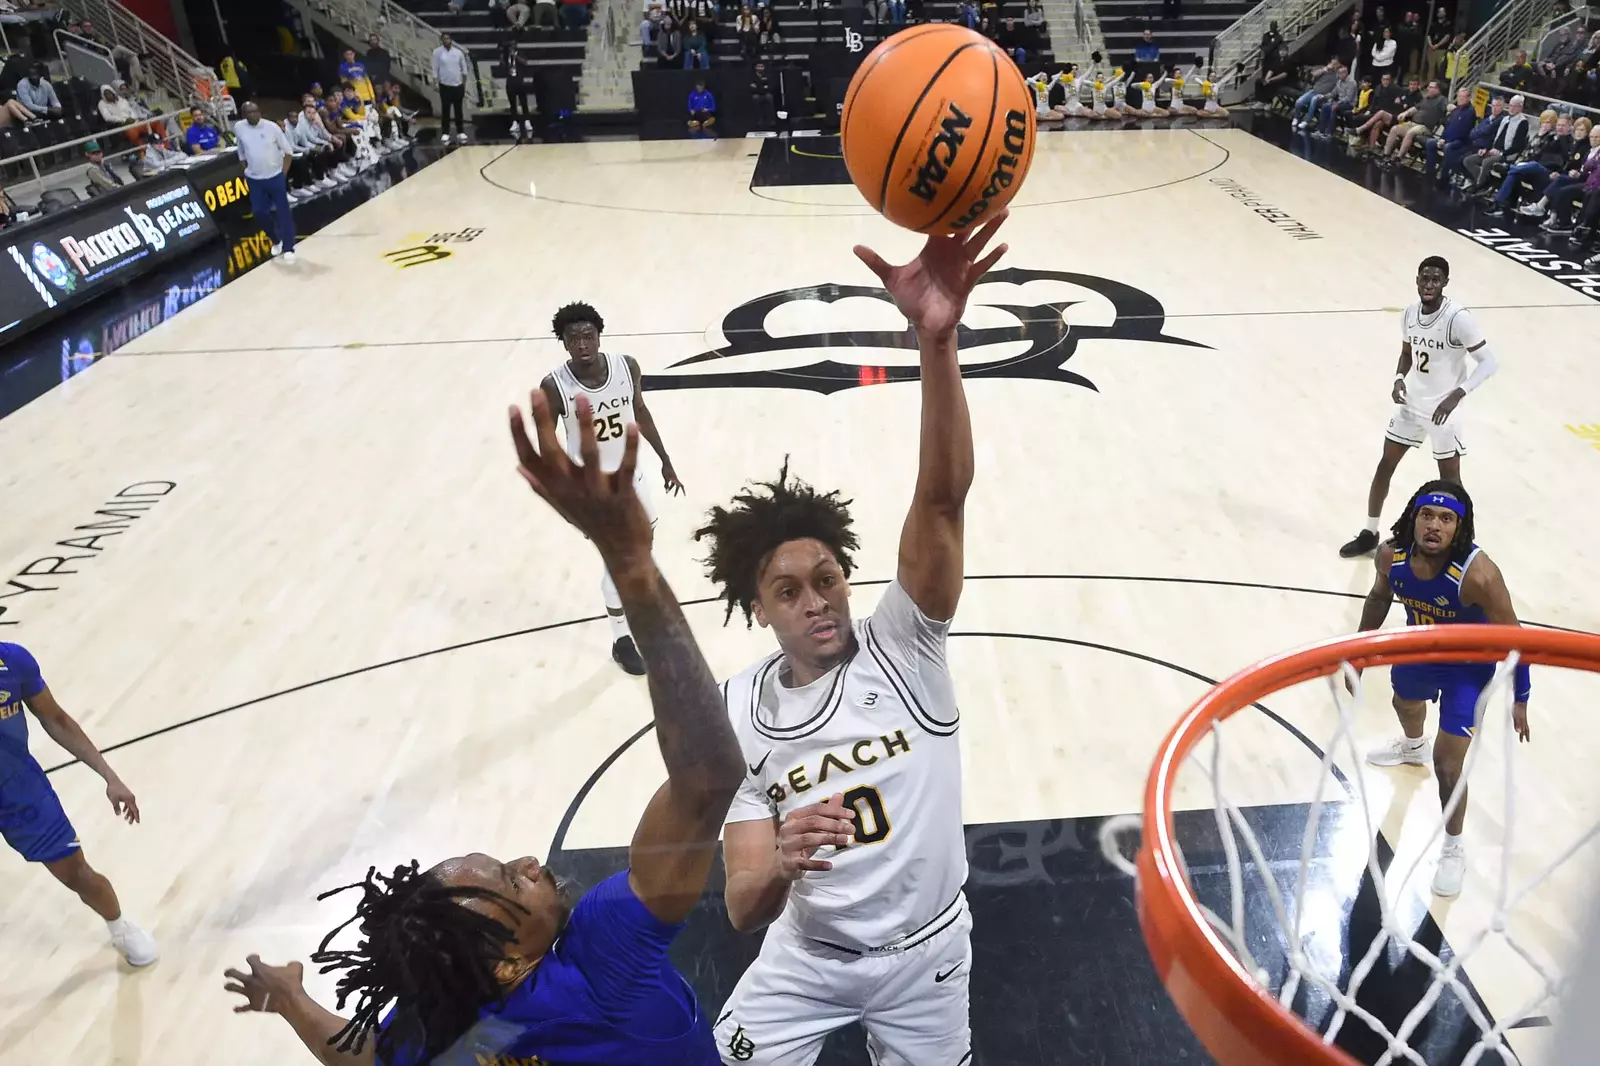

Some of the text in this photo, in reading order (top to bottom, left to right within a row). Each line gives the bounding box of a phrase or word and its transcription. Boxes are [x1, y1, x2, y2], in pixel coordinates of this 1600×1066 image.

[908, 101, 973, 205] NCAA
[215, 176, 250, 208] BEA
[156, 201, 206, 235] BEACH
[60, 234, 142, 276] PACIFICO
[1457, 227, 1583, 271] STATE
[1415, 350, 1430, 374] 12
[594, 412, 624, 442] 25
[0, 480, 177, 626] YRAMID
[766, 729, 911, 803] BEACH
